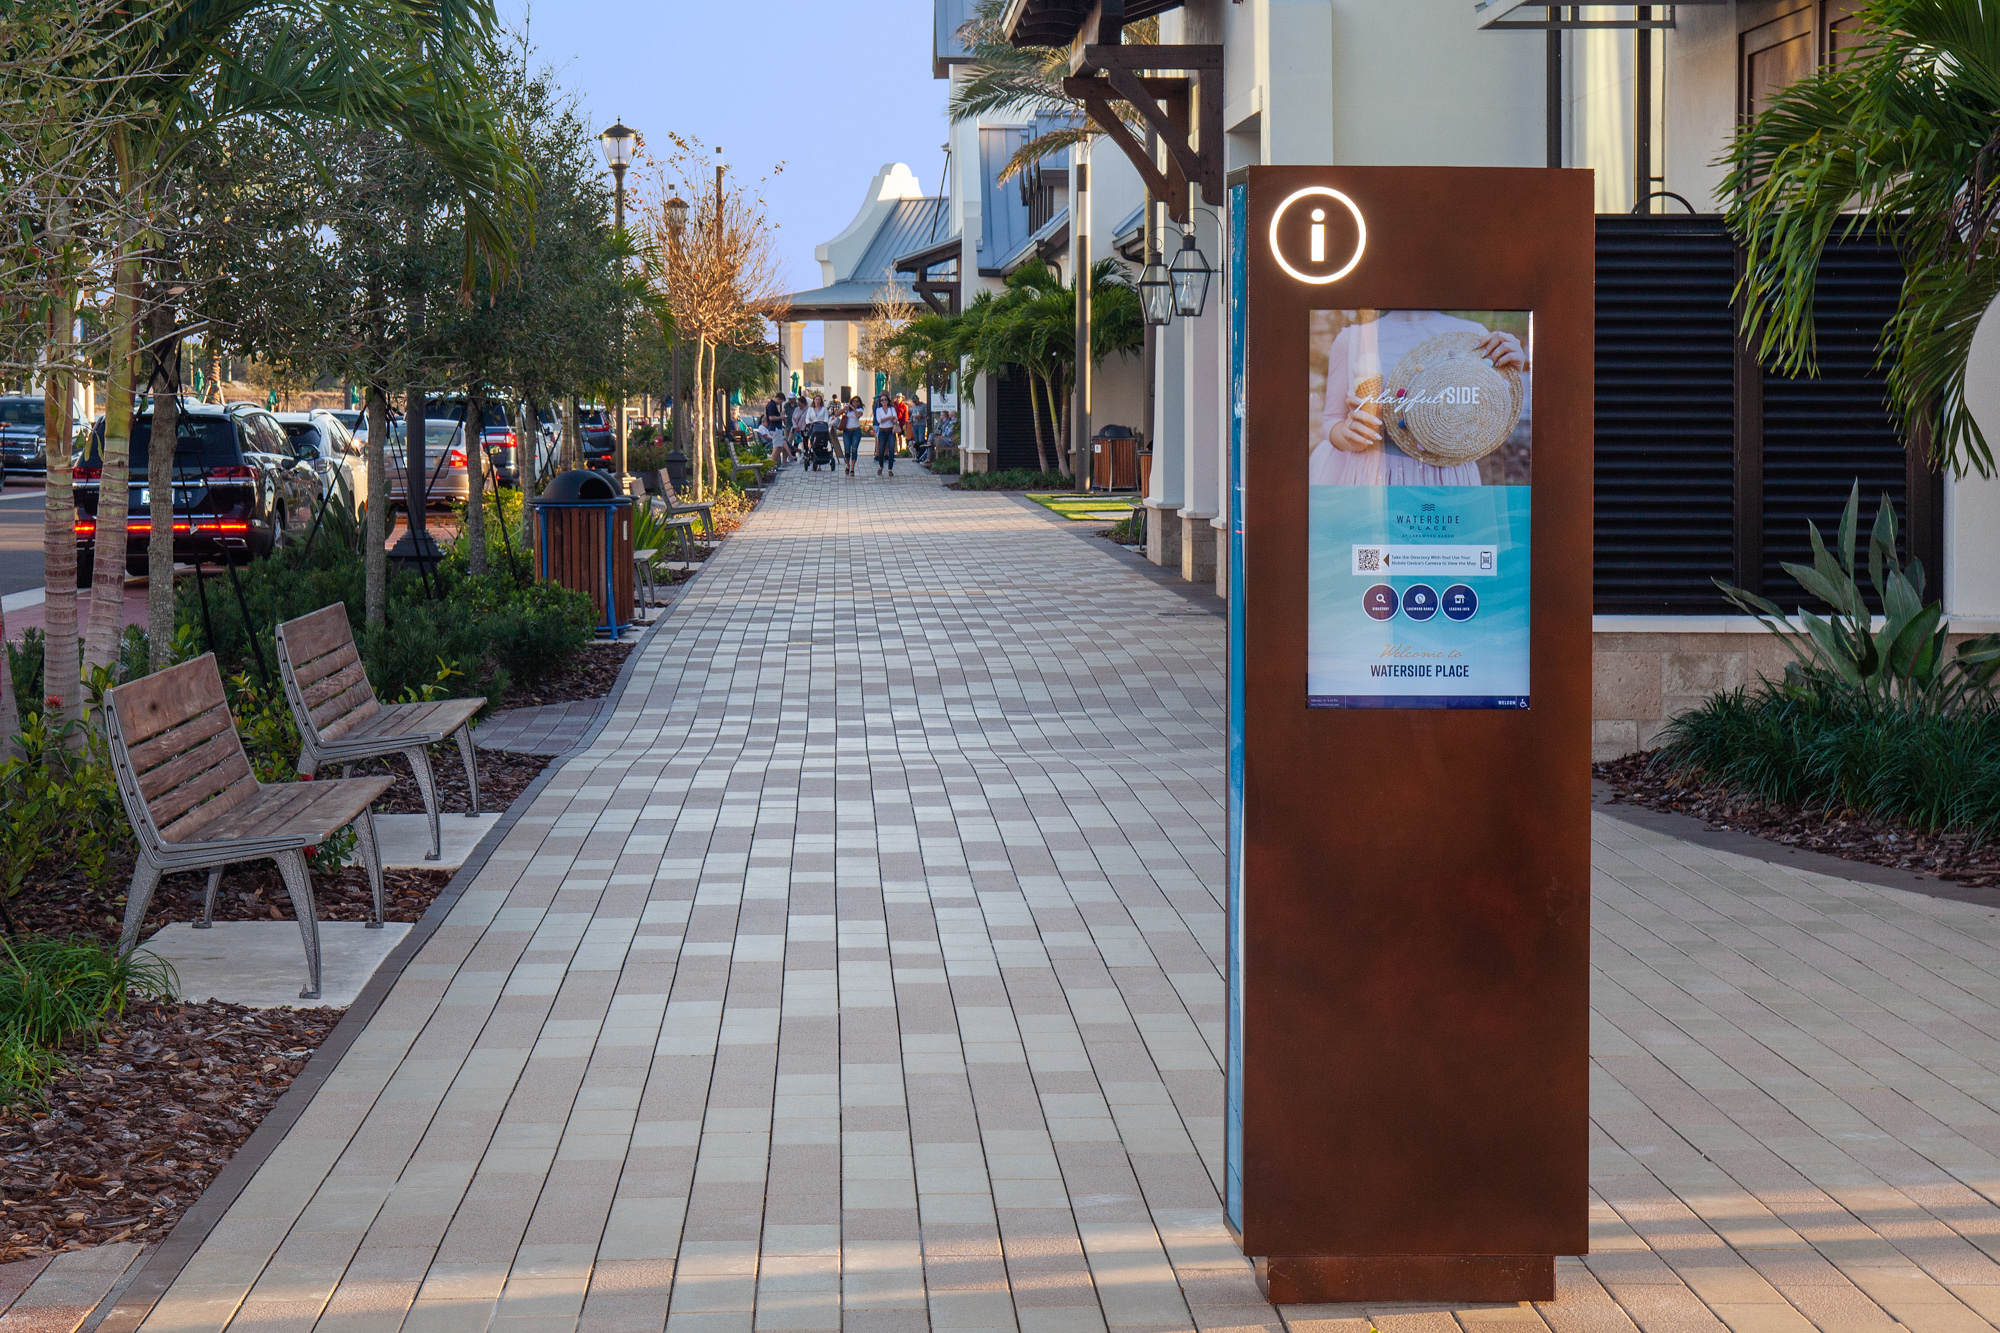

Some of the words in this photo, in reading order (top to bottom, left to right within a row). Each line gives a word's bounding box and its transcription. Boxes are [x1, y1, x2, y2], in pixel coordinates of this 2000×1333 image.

[1353, 388, 1448, 413] playful
[1446, 386, 1480, 405] SIDE
[1396, 515, 1460, 524] WATERSIDE
[1380, 643, 1444, 658] Welcome
[1447, 649, 1463, 658] to
[1370, 664, 1432, 677] WATERSIDE
[1435, 664, 1470, 677] PLACE
